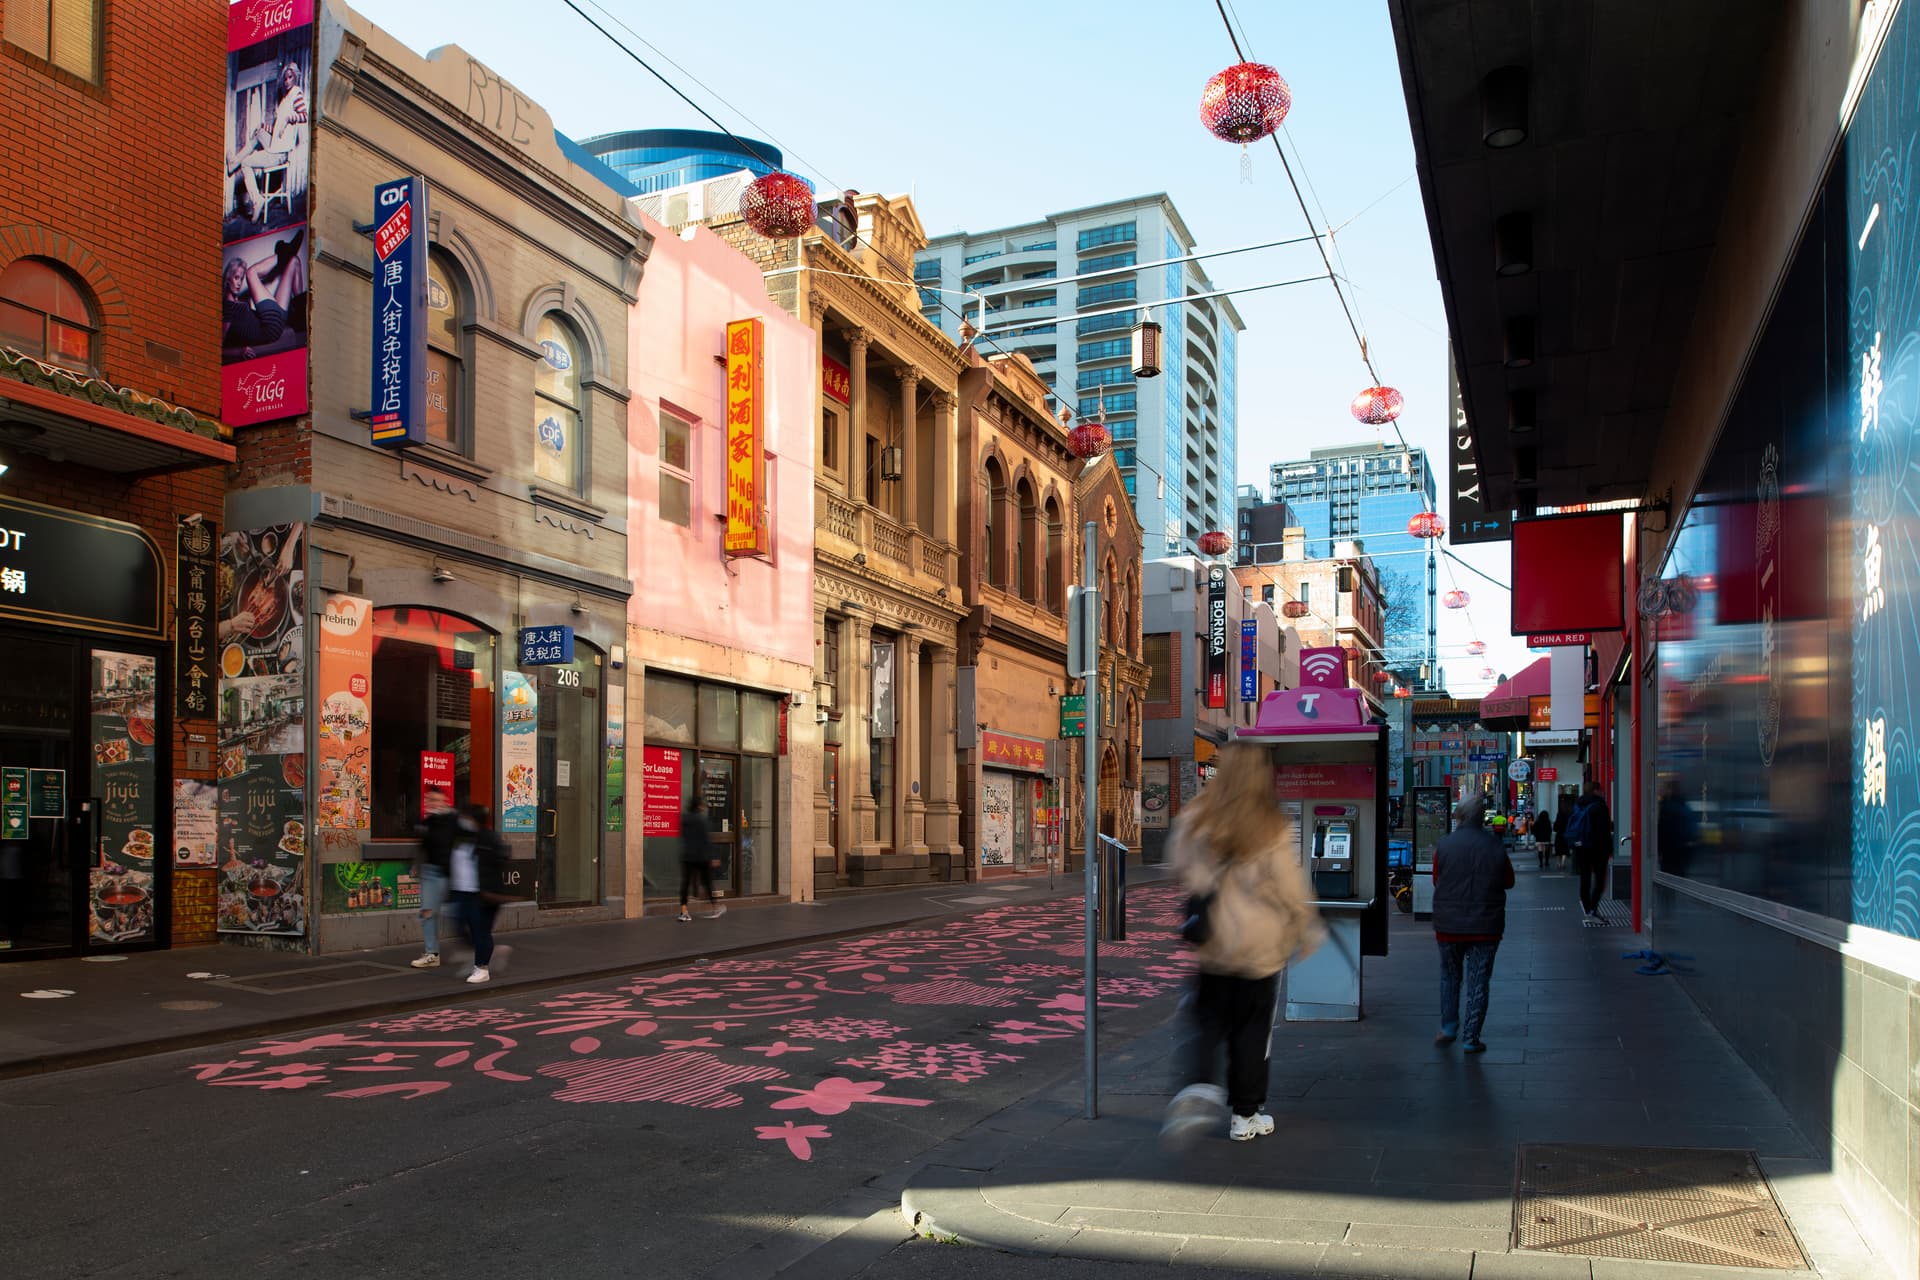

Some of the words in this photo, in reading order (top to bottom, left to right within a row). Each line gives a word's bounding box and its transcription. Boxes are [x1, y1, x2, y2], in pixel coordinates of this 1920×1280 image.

[264, 0, 293, 28] UGG
[380, 209, 408, 241] DUTY
[382, 224, 409, 255] FREE
[382, 260, 403, 412] 唐人街免税店
[255, 378, 285, 402] UGG
[255, 403, 284, 413] AUSTRALIA
[729, 469, 752, 501] LING
[731, 499, 751, 527] NAN
[325, 613, 357, 628] rebirth
[1214, 600, 1225, 656] BORNGA
[524, 630, 562, 645] 唐人街
[1533, 634, 1562, 644] CHINA
[1565, 634, 1585, 642] RED
[524, 646, 562, 661] 免税店
[557, 668, 580, 687] 206
[653, 764, 673, 774] Lease
[987, 786, 997, 797] For
[983, 802, 1000, 814] Lease
